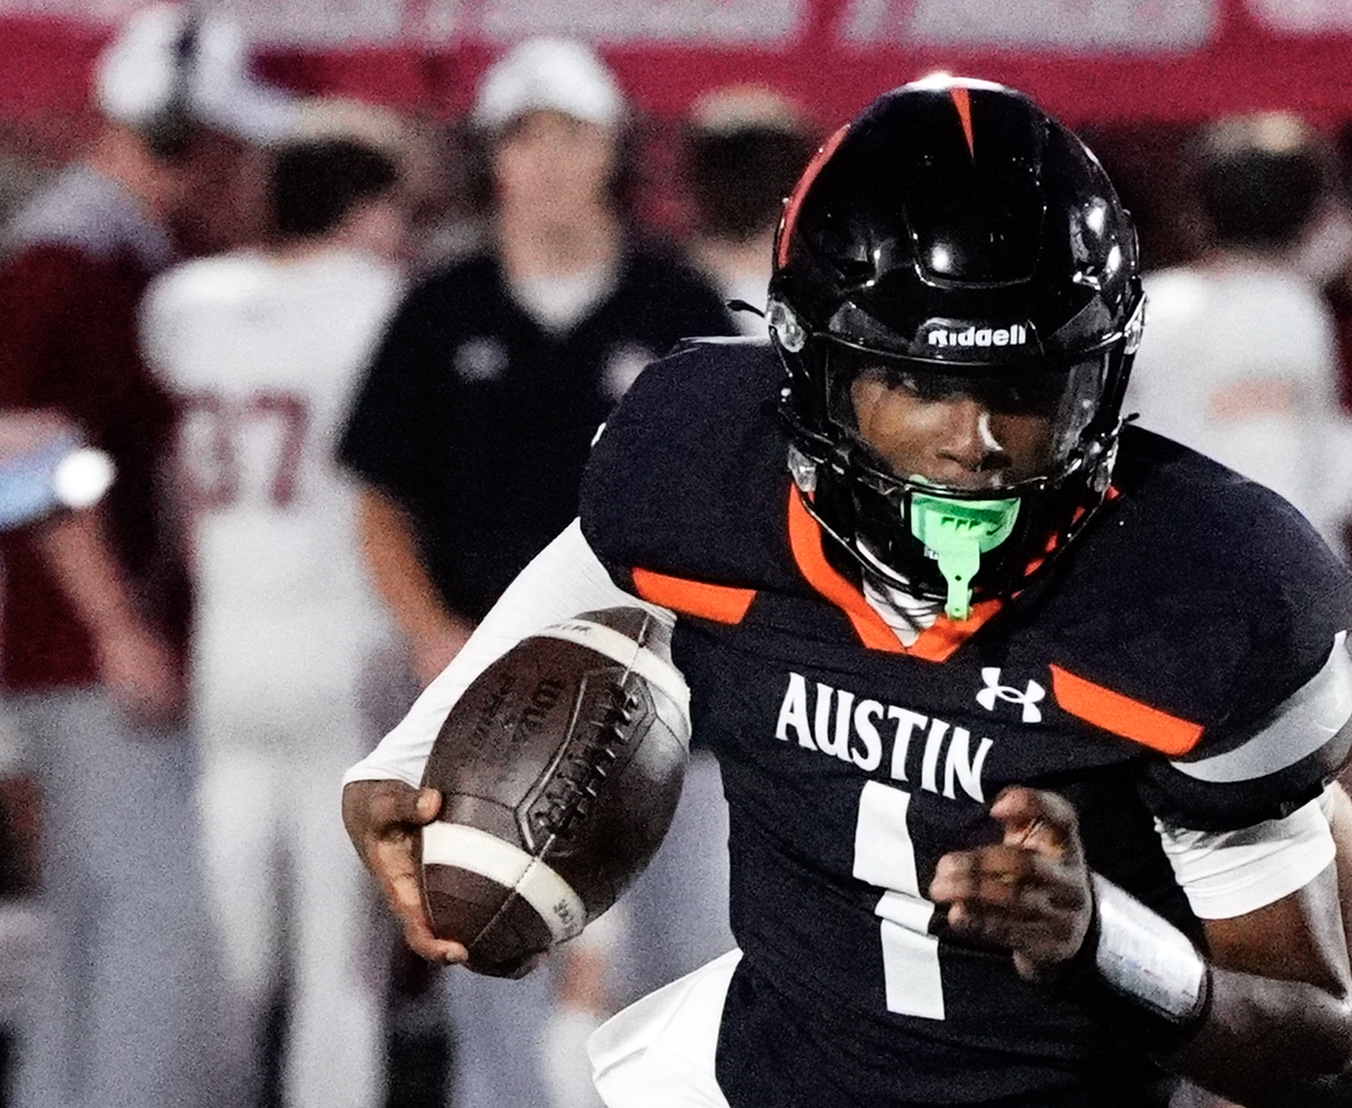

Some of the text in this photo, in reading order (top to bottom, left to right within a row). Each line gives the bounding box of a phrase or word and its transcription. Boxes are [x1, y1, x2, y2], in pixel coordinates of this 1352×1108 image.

[928, 324, 1026, 348] Riddell
[775, 672, 994, 804] AUSTIN
[852, 779, 946, 1020] 1
